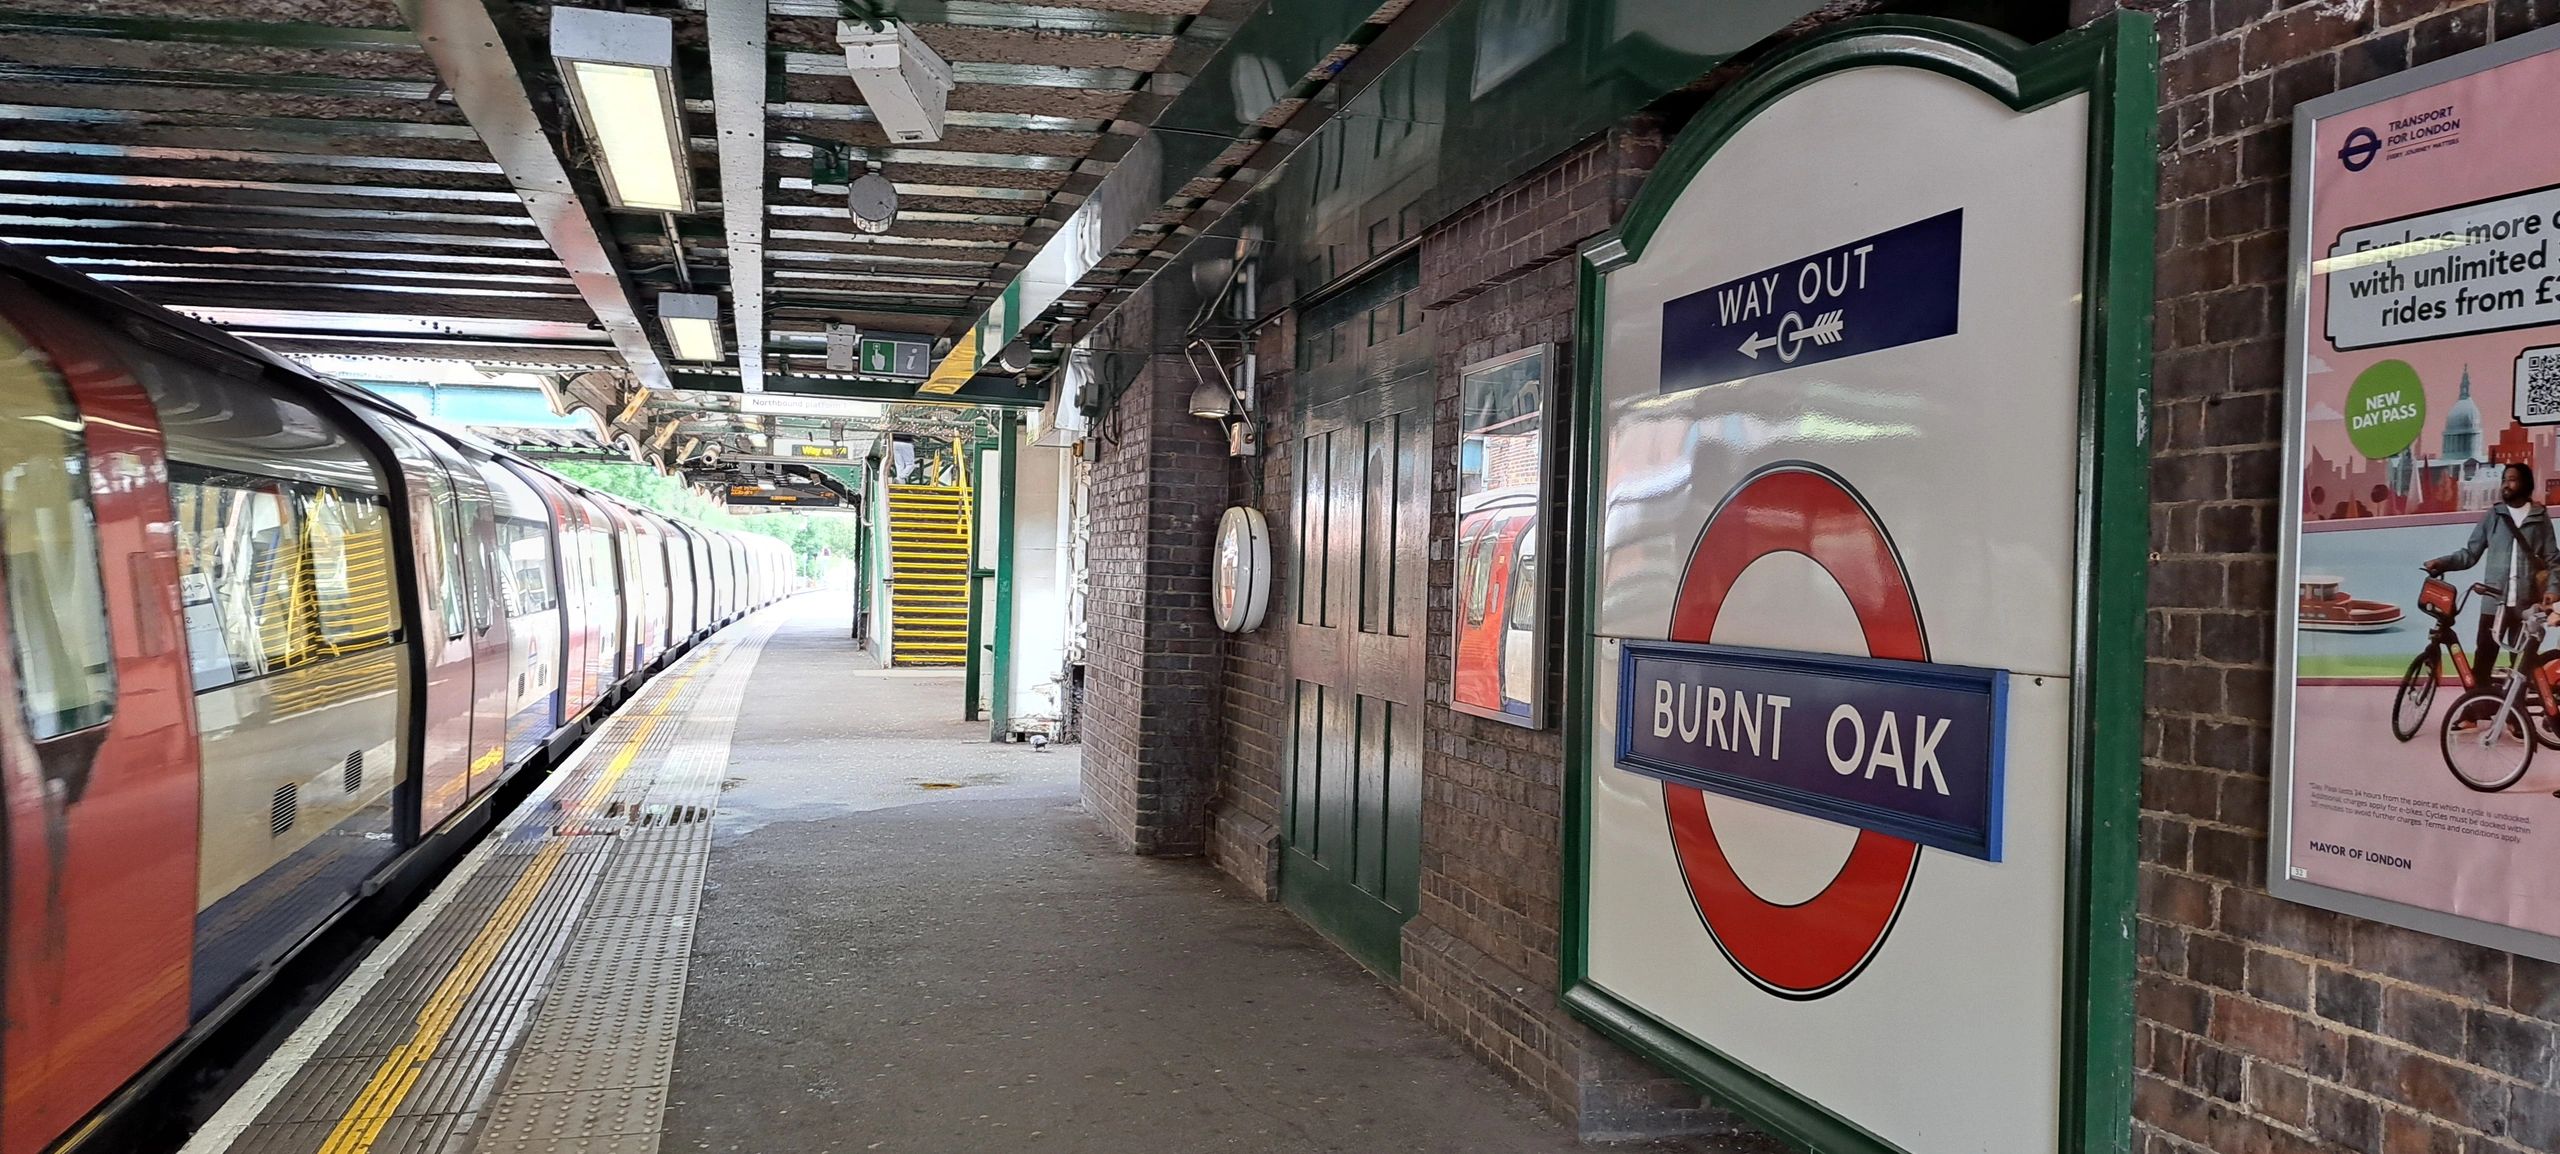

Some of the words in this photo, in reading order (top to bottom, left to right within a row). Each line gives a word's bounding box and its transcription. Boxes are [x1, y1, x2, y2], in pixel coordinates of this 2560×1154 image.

[2386, 133, 2408, 146] FOR
[2410, 119, 2461, 140] LONDON
[2388, 106, 2454, 132] TRANSPORT
[2465, 214, 2542, 246] more
[2349, 265, 2405, 299] with
[2414, 238, 2548, 289] unlimited
[1717, 272, 1780, 327] WAY
[1798, 244, 1874, 305] OUT
[2381, 295, 2447, 327] rides
[2455, 287, 2524, 316] from
[752, 398, 803, 408] Northbound
[2366, 391, 2402, 411] NEW
[2352, 408, 2380, 430] DAY
[2381, 403, 2417, 424] PASS
[1652, 679, 1791, 761] BURNT
[1824, 703, 1952, 796] OAK
[2363, 791, 2381, 800] hours
[2382, 793, 2399, 802] from
[2412, 799, 2431, 808] point
[2440, 803, 2460, 813] which
[2369, 802, 2387, 811] apply
[2387, 804, 2398, 812] for
[2425, 810, 2448, 821] Cycles
[2469, 817, 2478, 825] be
[2479, 819, 2506, 831] docked
[2507, 823, 2532, 834] within
[2372, 811, 2396, 821] further
[2424, 819, 2446, 830] Terms
[2447, 824, 2460, 833] and
[2461, 826, 2500, 840] conditions
[2310, 841, 2346, 857] MAYOR
[2348, 848, 2363, 860] OF
[2365, 851, 2412, 870] LONDON
